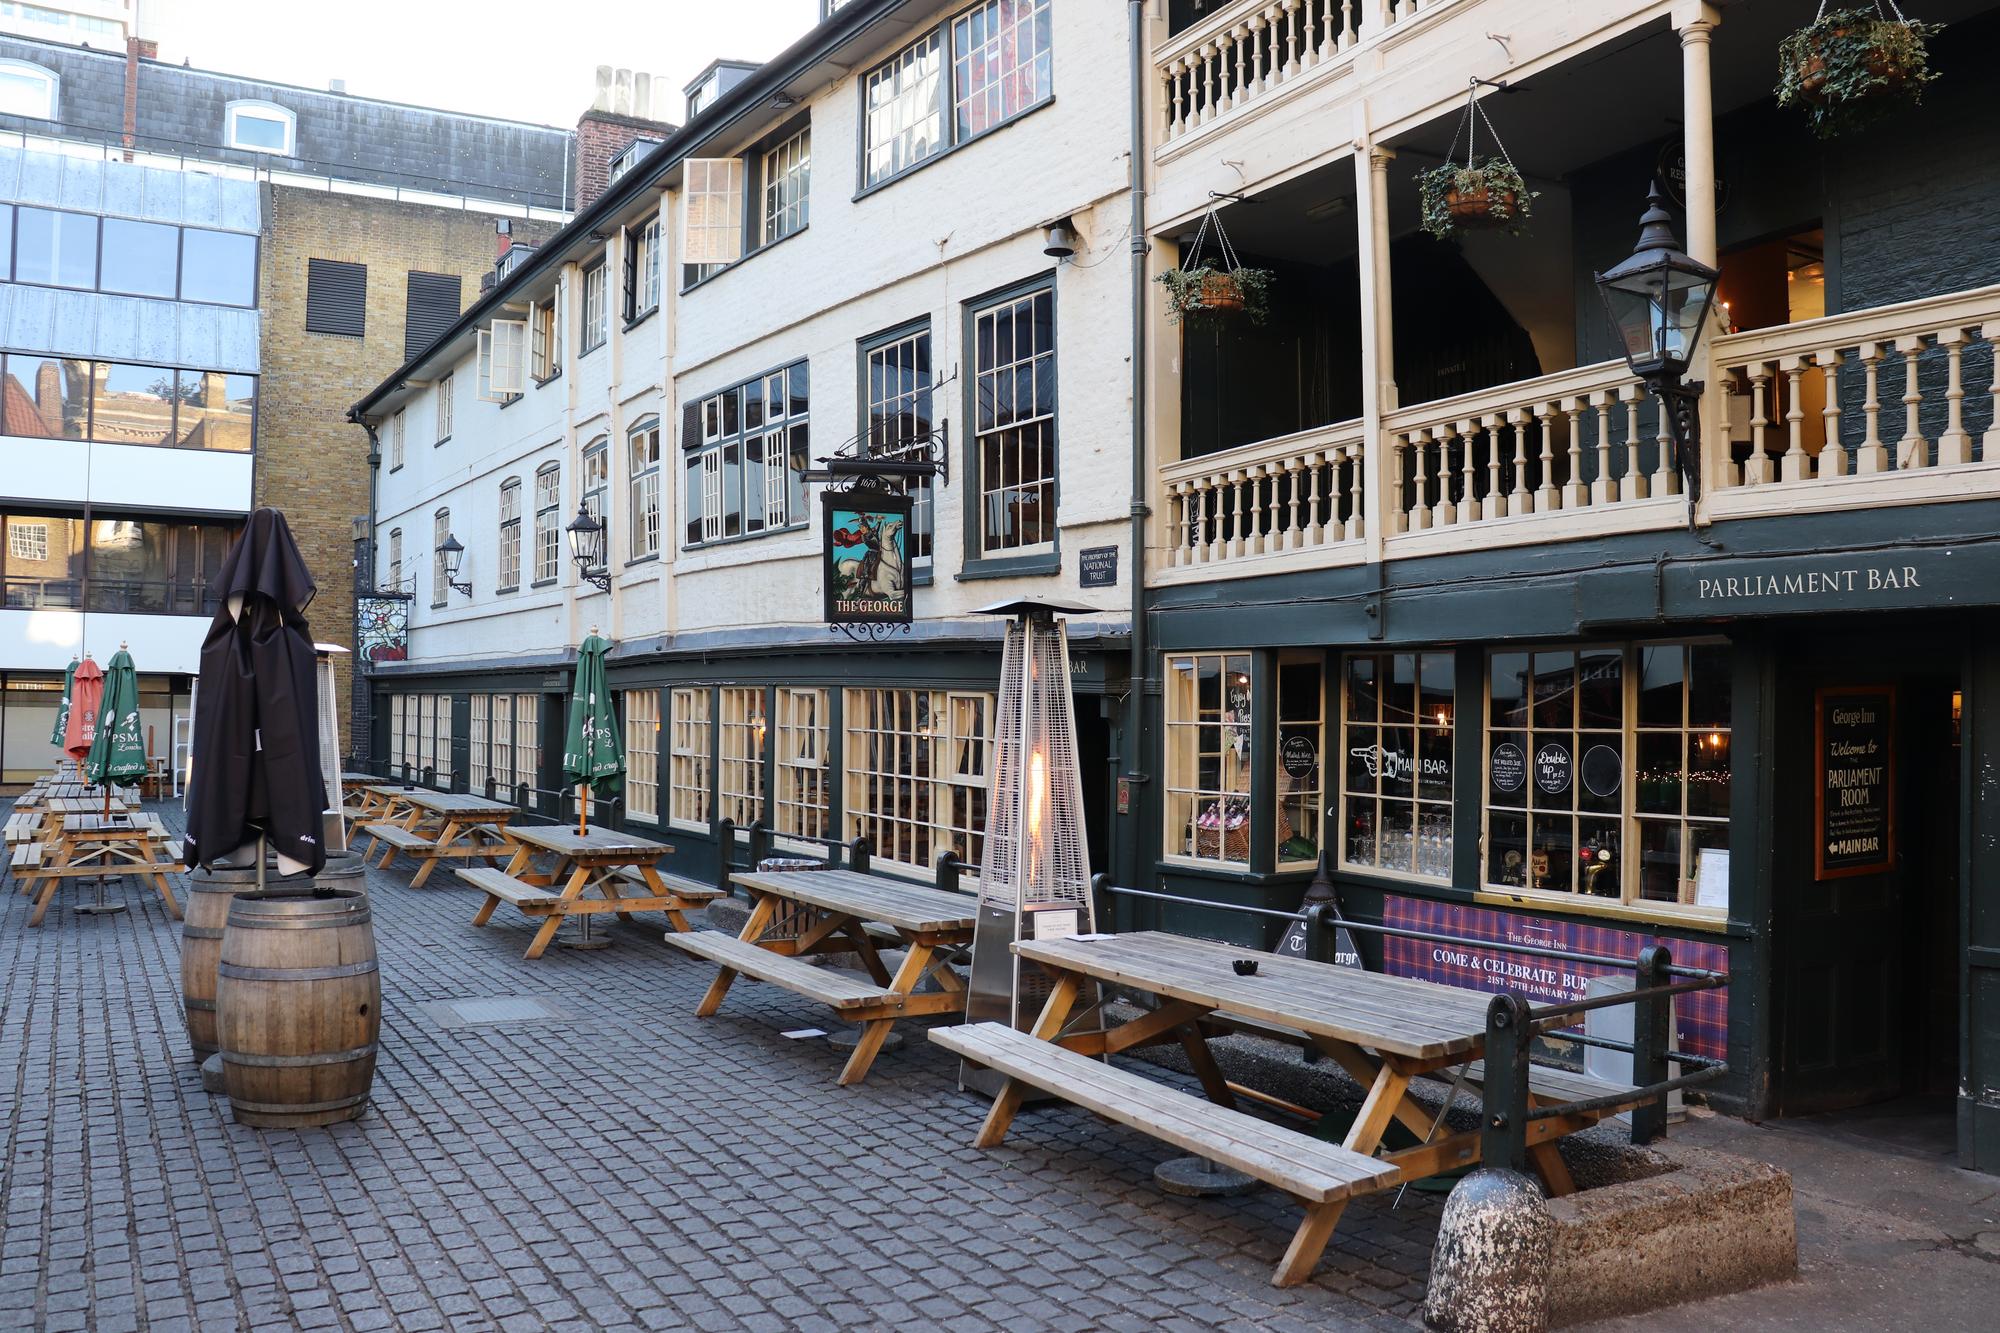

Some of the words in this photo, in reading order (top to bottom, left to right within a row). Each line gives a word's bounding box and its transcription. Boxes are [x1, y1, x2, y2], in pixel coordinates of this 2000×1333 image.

[860, 478, 877, 488] 1676
[1083, 561, 1112, 571] NATIONAL
[1090, 571, 1106, 580] TRUST
[1699, 570, 1857, 598] PARLIAMENT
[1867, 566, 1920, 590] BAR
[836, 600, 856, 612] THE
[859, 600, 903, 613] GEORGE
[1068, 660, 1088, 673] BAR
[1833, 708, 1860, 727] George
[1861, 707, 1875, 723] Inn
[1830, 740, 1866, 756] Welcome
[1868, 739, 1879, 753] to
[1538, 751, 1568, 765] Double
[1424, 759, 1449, 775] BAR
[1828, 767, 1883, 789] PARLIAMENT
[1841, 788, 1869, 807] ROOM
[1839, 838, 1861, 855] MAIN
[1862, 837, 1879, 852] BAR
[1433, 949, 1468, 969] COME
[1470, 958, 1481, 970] &
[1483, 958, 1557, 985] CELEBRATE
[1487, 974, 1505, 986] 21ST
[1510, 980, 1528, 992] 27TH
[1529, 984, 1569, 1000] JANUARY
